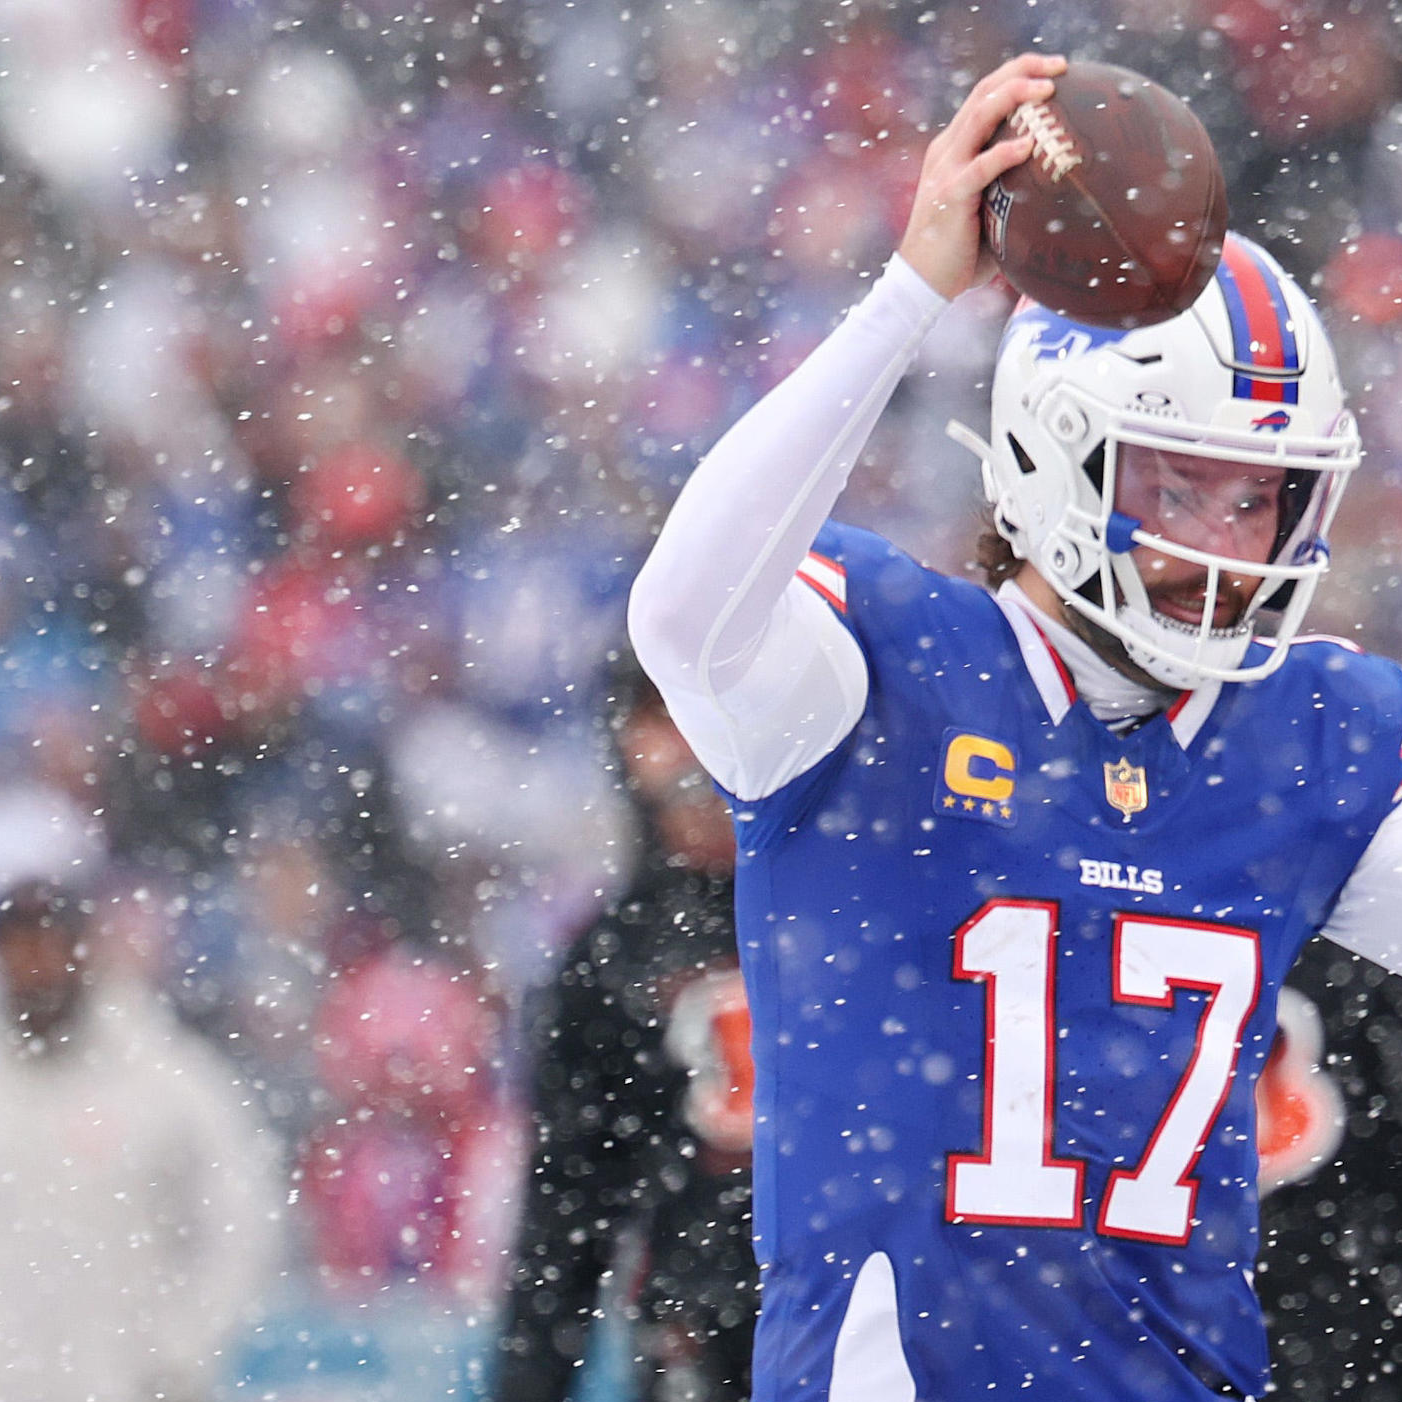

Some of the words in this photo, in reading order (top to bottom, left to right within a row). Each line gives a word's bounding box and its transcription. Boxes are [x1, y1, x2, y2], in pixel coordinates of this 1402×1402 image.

[944, 733, 1015, 802] C
[1079, 858, 1164, 895] BILLS
[945, 898, 1260, 1246] 17
